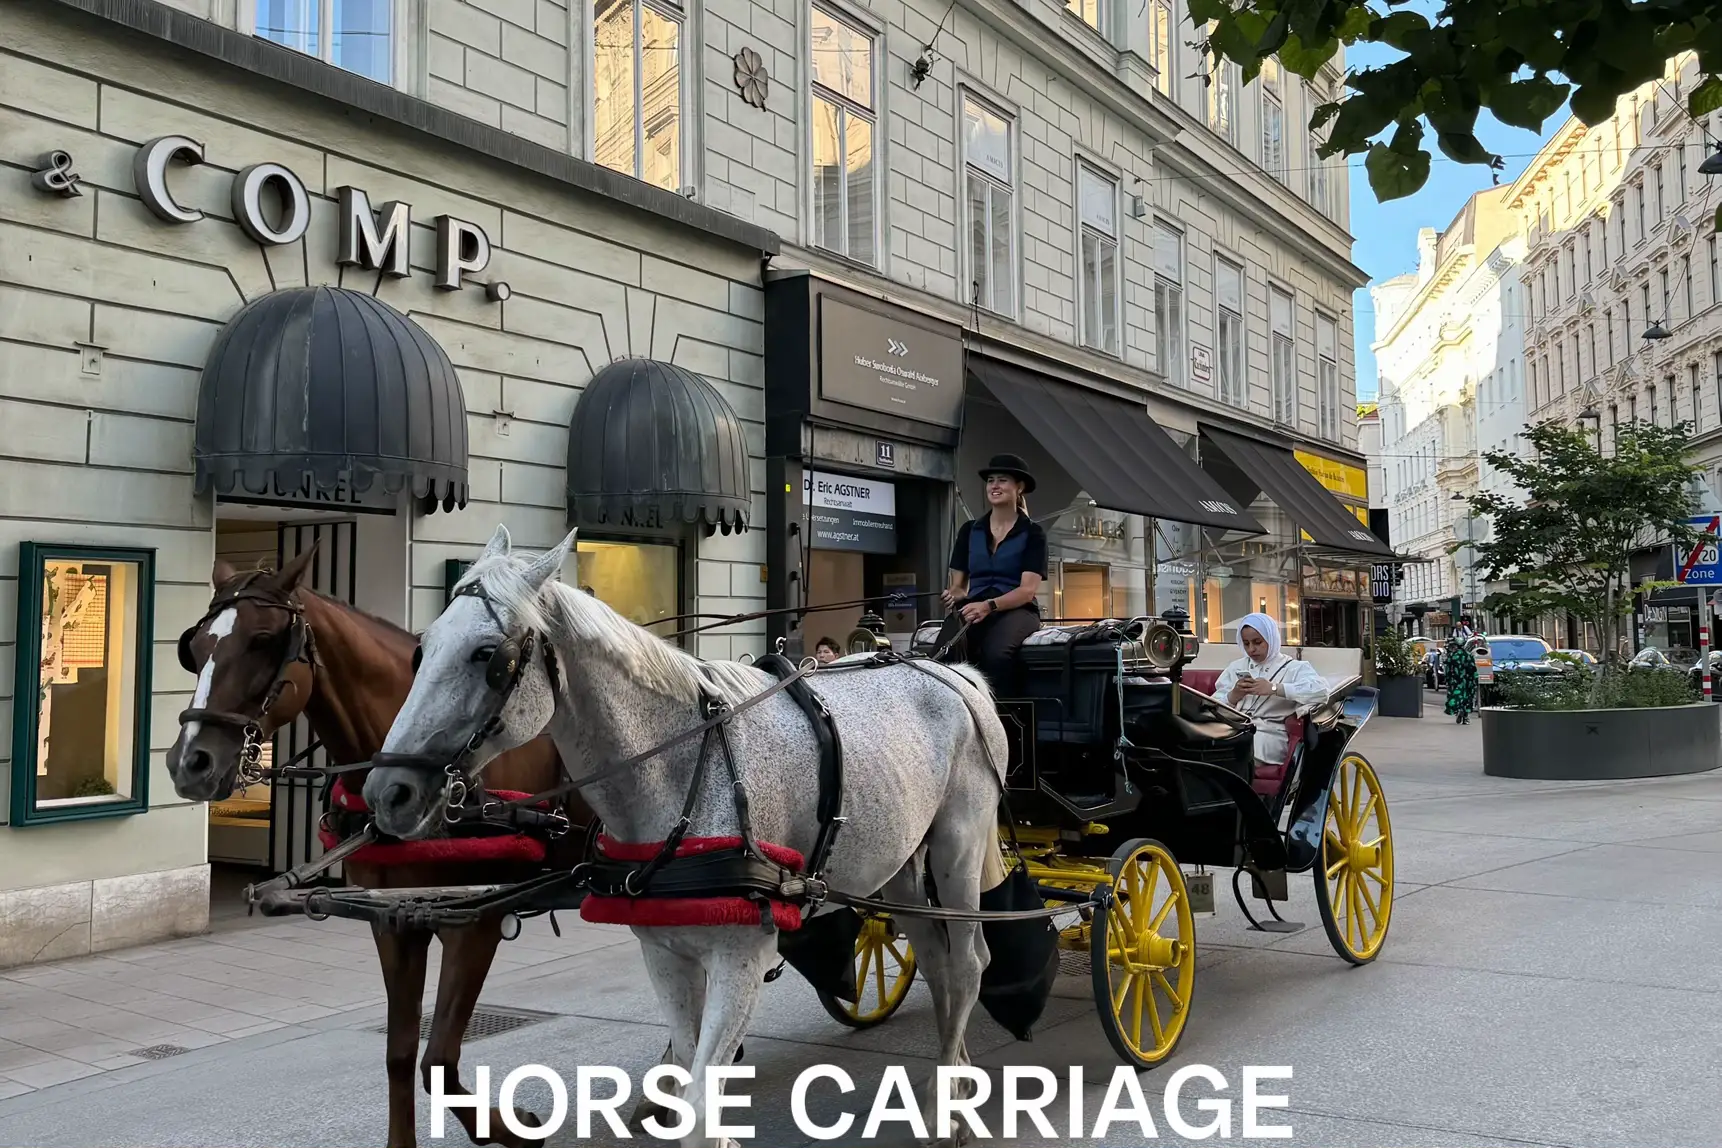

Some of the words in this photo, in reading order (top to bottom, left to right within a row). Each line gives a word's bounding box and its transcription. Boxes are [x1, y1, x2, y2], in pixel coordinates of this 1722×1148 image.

[32, 149, 82, 198] &
[881, 445, 890, 458] 11
[818, 481, 832, 493] Eric
[834, 484, 870, 498] AGSTNER
[817, 530, 859, 542] www.agstner.at
[1702, 549, 1717, 562] 20
[1684, 568, 1715, 579] Zone
[1191, 883, 1210, 896] 48
